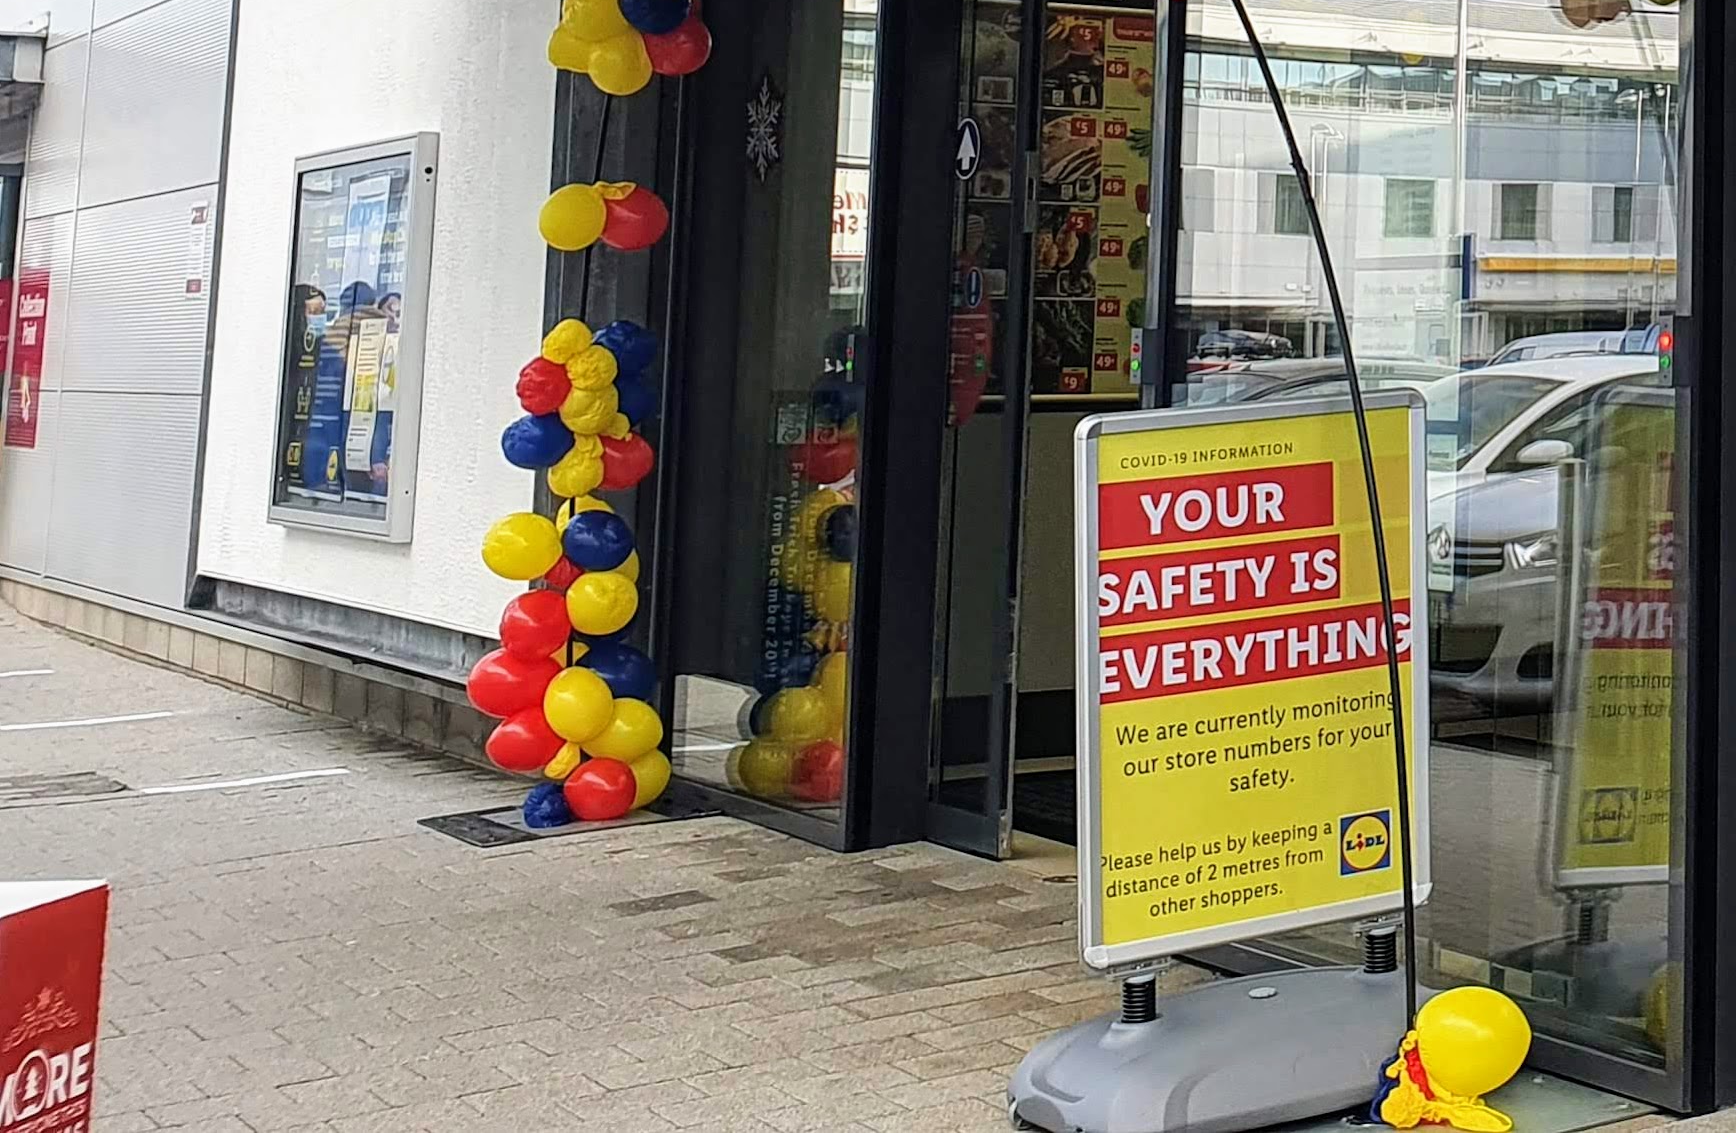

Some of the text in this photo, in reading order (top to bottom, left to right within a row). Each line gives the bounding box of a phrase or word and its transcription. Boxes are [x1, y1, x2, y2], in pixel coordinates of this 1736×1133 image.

[1119, 442, 1294, 470] COVID-19 INFORMATION
[771, 496, 788, 537] from
[1139, 481, 1286, 535] YOUR
[765, 544, 784, 633] December
[1098, 547, 1339, 616] SAFETY IS
[1100, 612, 1413, 695] EVERYTHING
[1115, 691, 1396, 746] We are currently monitoring
[1123, 720, 1392, 777] our store numbers for your
[1229, 767, 1295, 792] safety.
[1159, 842, 1197, 866] help
[1202, 838, 1222, 857] us
[1227, 833, 1248, 859] by
[1252, 822, 1318, 848] keeping
[1323, 821, 1333, 836] a
[1105, 848, 1324, 899] distance of 2 metres from
[1149, 880, 1284, 918] other shoppers.
